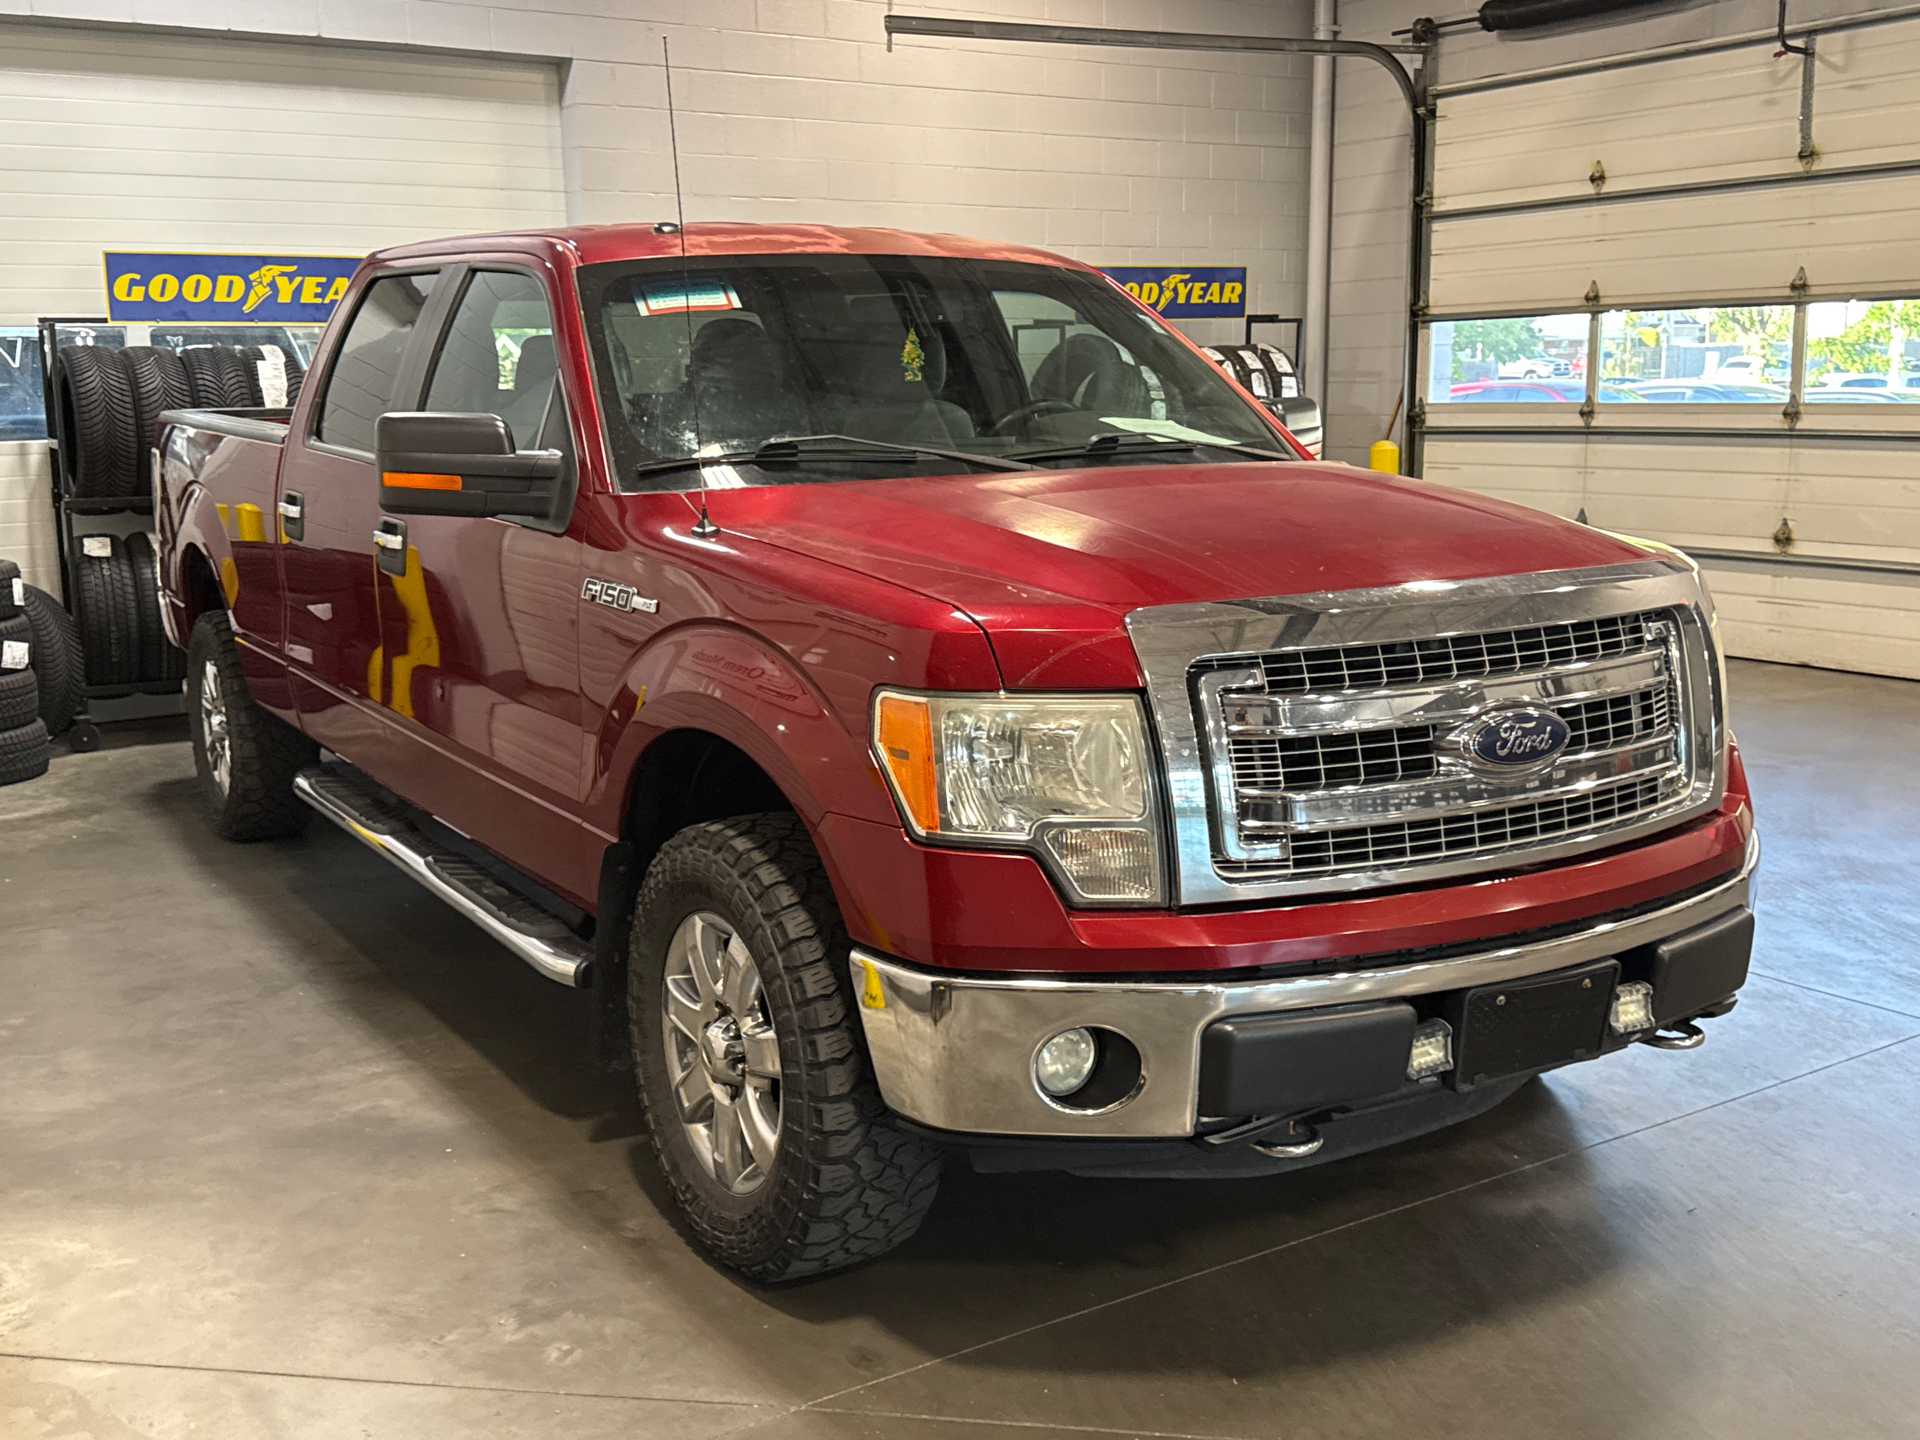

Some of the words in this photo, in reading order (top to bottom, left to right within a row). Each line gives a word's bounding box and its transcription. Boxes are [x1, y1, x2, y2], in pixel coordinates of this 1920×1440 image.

[113, 272, 349, 304] GOODYEA
[1124, 281, 1243, 304] ODYEAR
[582, 579, 632, 610] F-150
[1495, 720, 1553, 757] Ford
